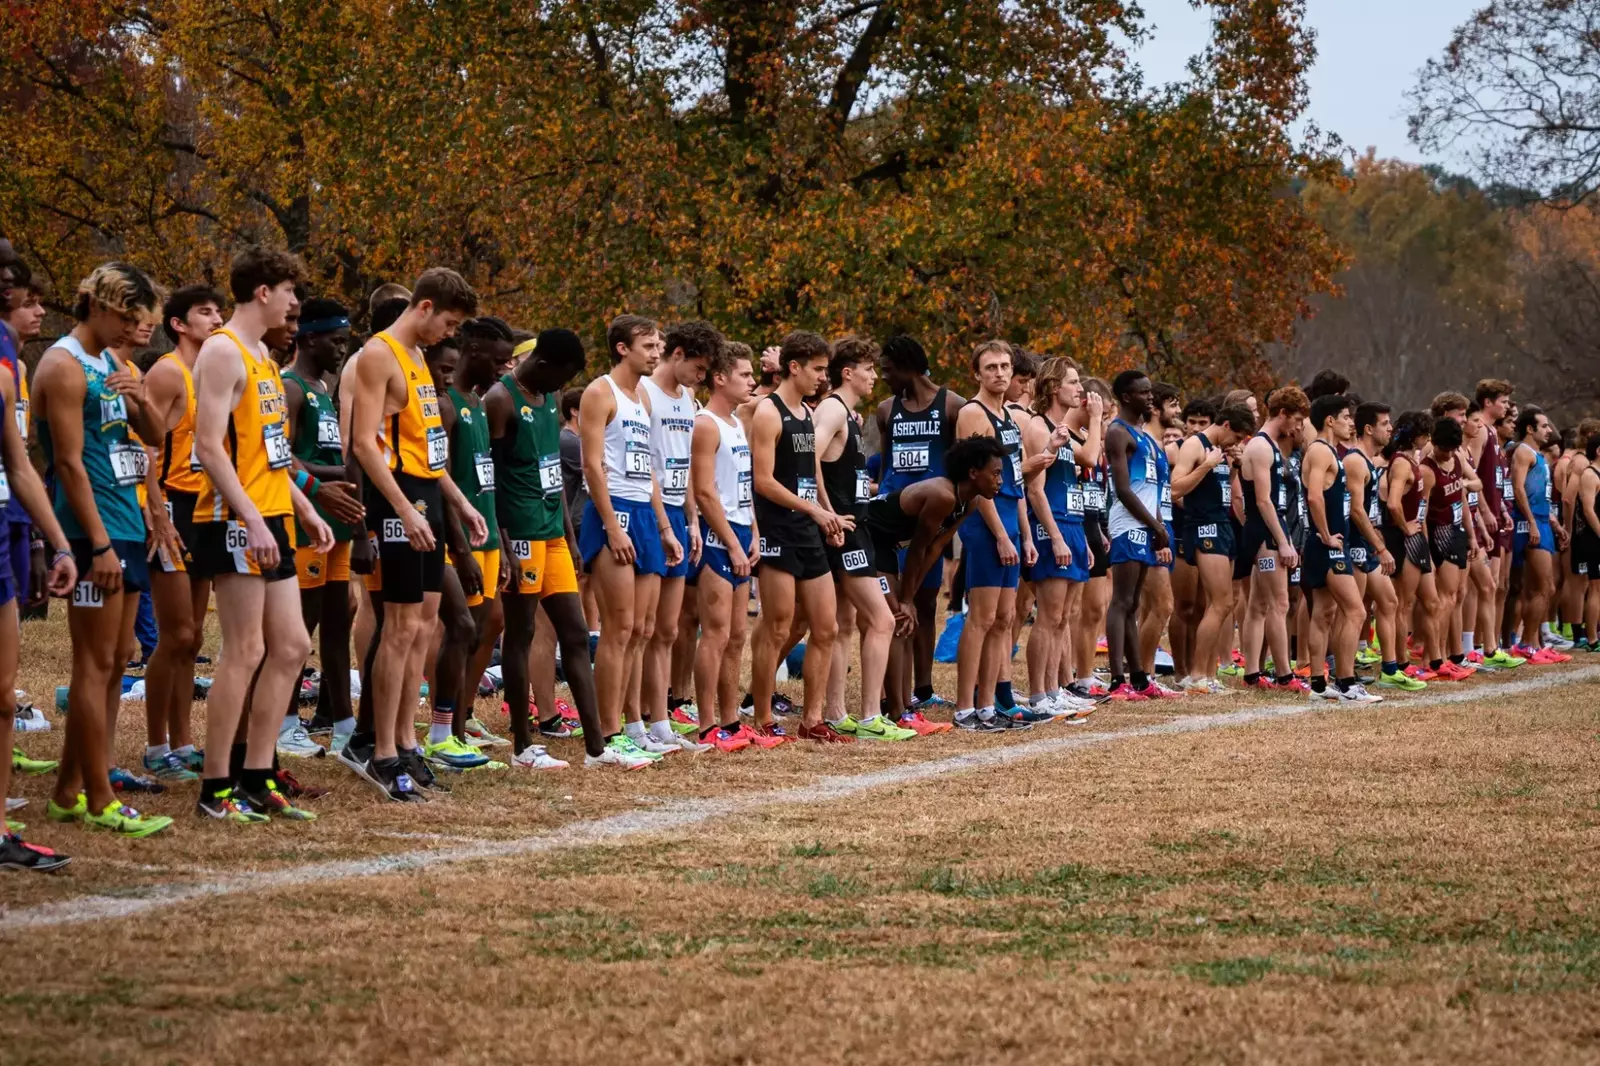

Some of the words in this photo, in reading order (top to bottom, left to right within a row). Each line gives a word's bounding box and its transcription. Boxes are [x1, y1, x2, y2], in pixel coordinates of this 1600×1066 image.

[661, 418, 694, 428] MOREHEAD
[892, 420, 941, 437] ASHEVILLE
[899, 451, 922, 467] 604
[385, 520, 406, 538] 56
[1128, 529, 1148, 543] 576
[1199, 525, 1216, 536] 530
[843, 551, 866, 568] 660
[1350, 548, 1366, 561] 527
[1259, 558, 1274, 570] 528
